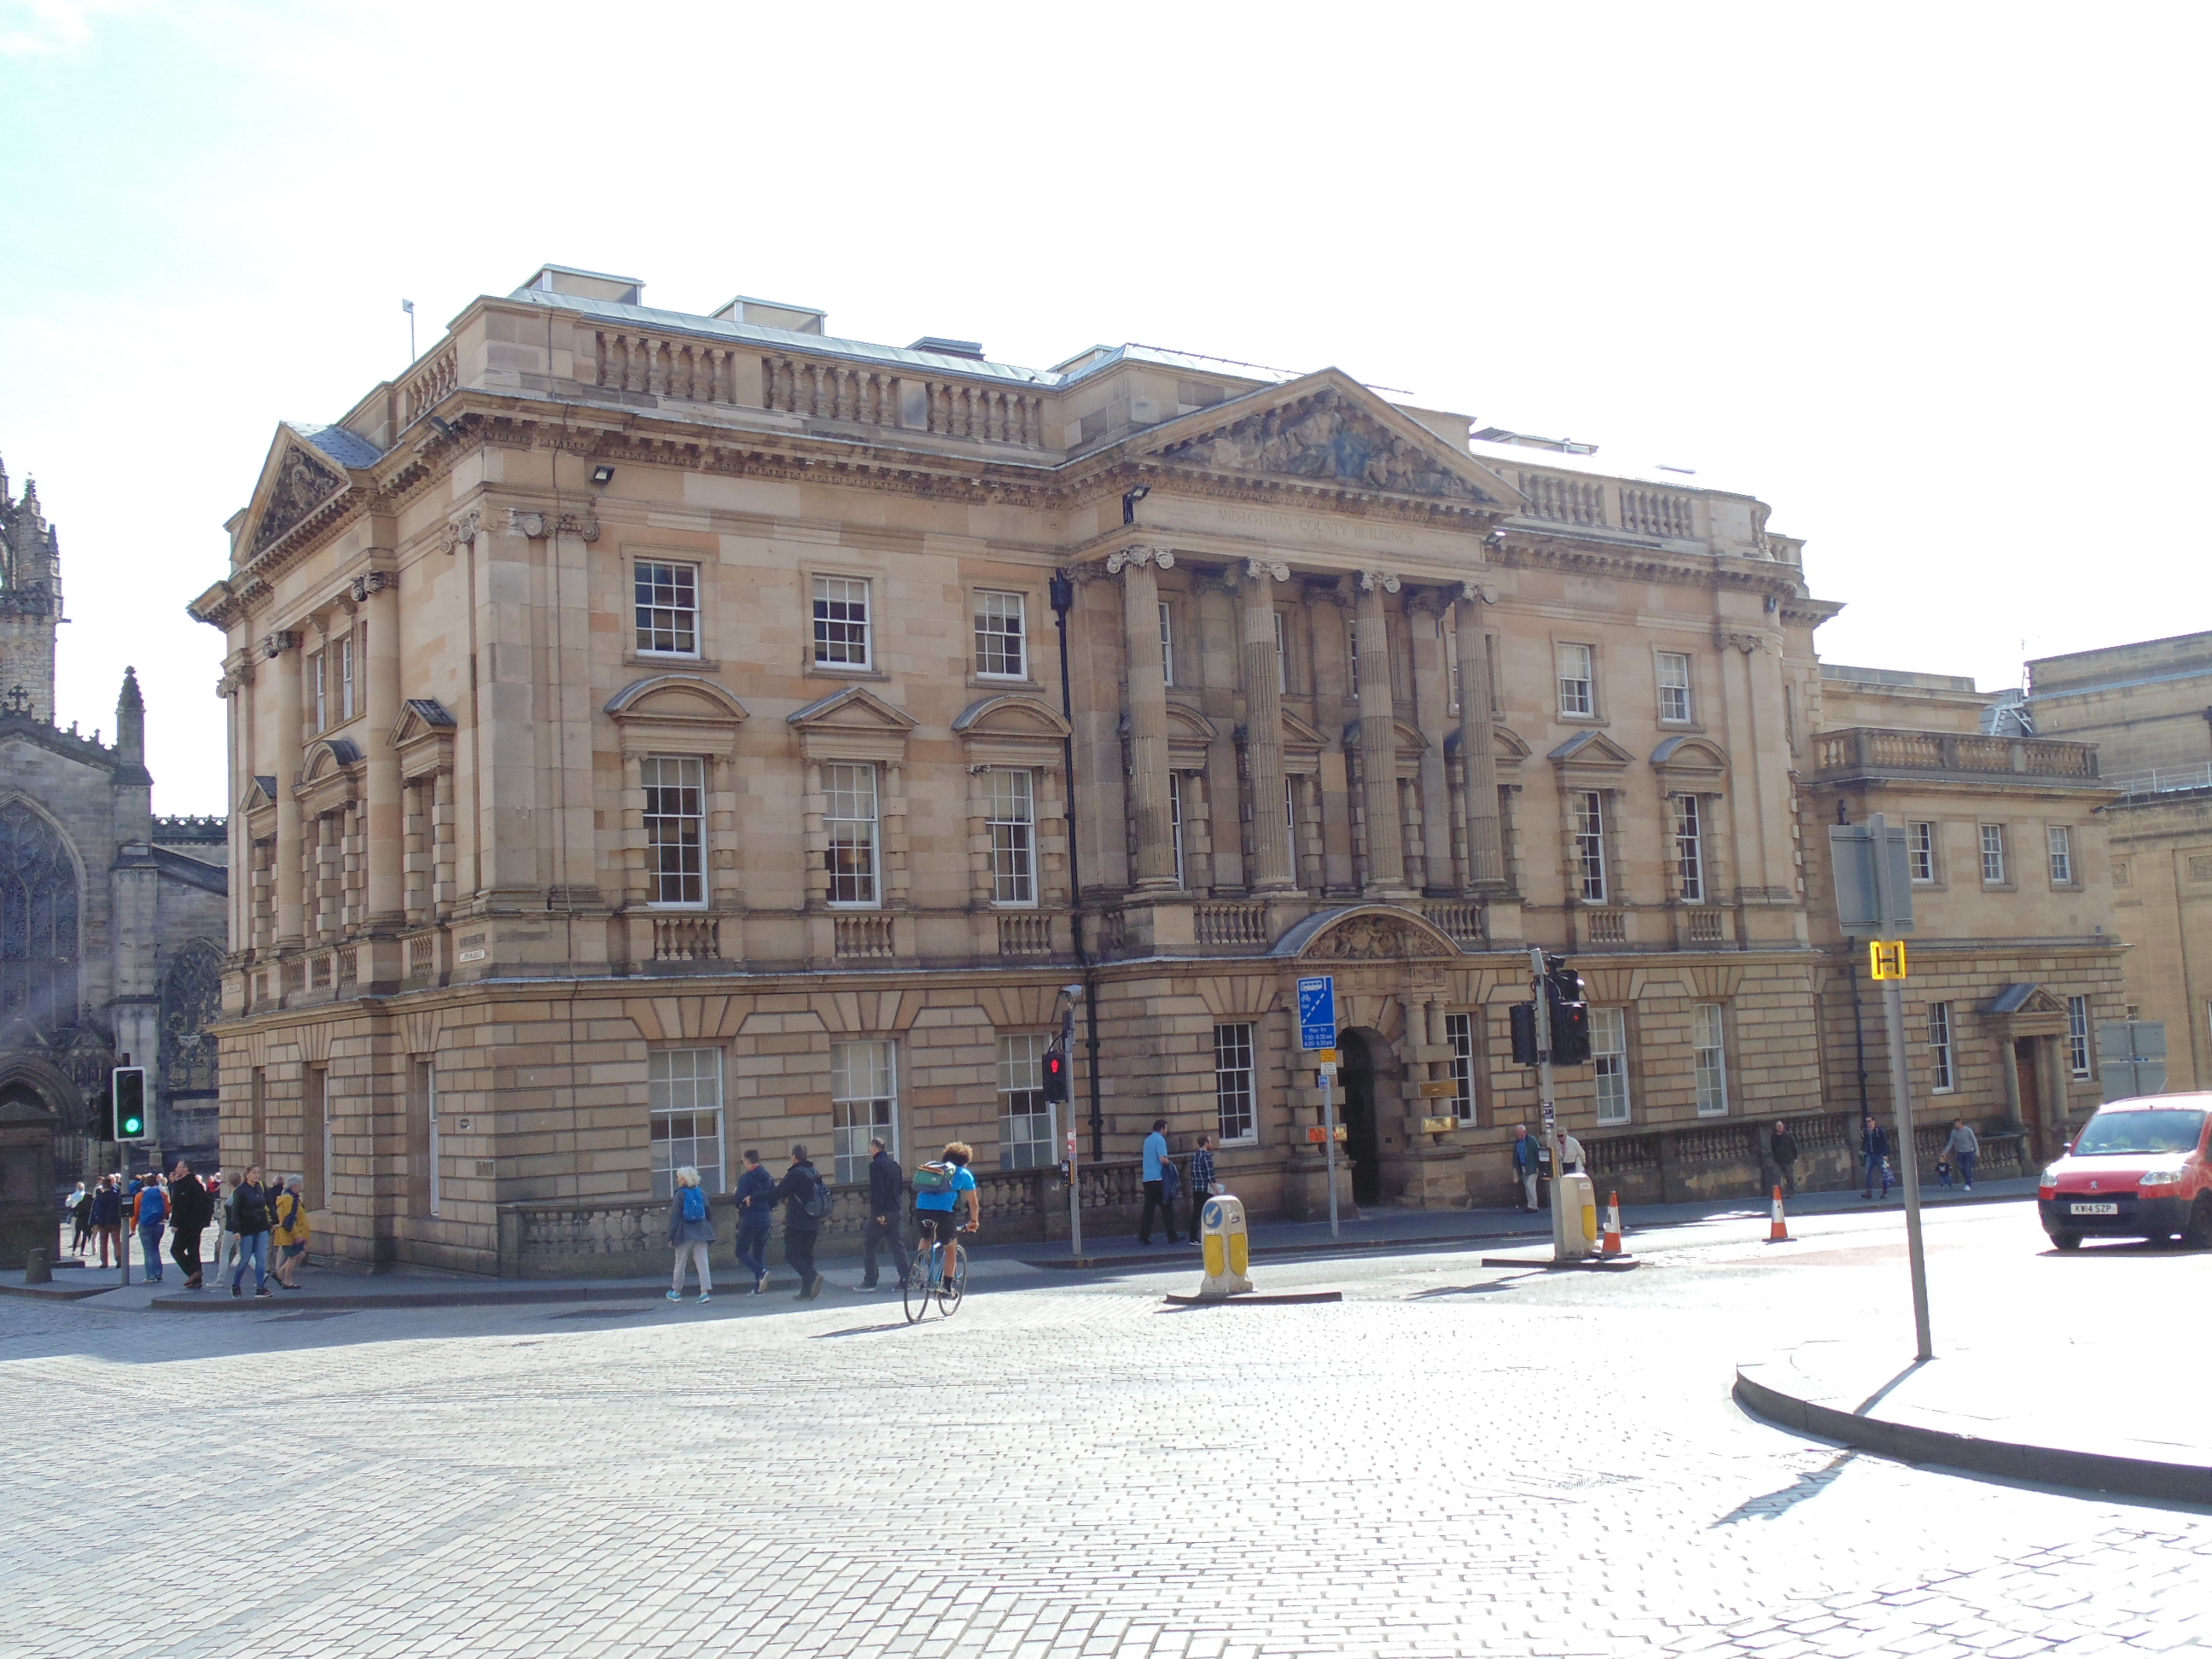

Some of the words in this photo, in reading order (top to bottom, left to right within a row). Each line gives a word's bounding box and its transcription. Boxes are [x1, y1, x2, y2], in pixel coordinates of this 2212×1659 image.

[1300, 519, 1347, 536] COUNTY
[1354, 526, 1413, 544] BUILDINGS
[2075, 1204, 2093, 1213] KW14
[2095, 1204, 2112, 1213] SZP
